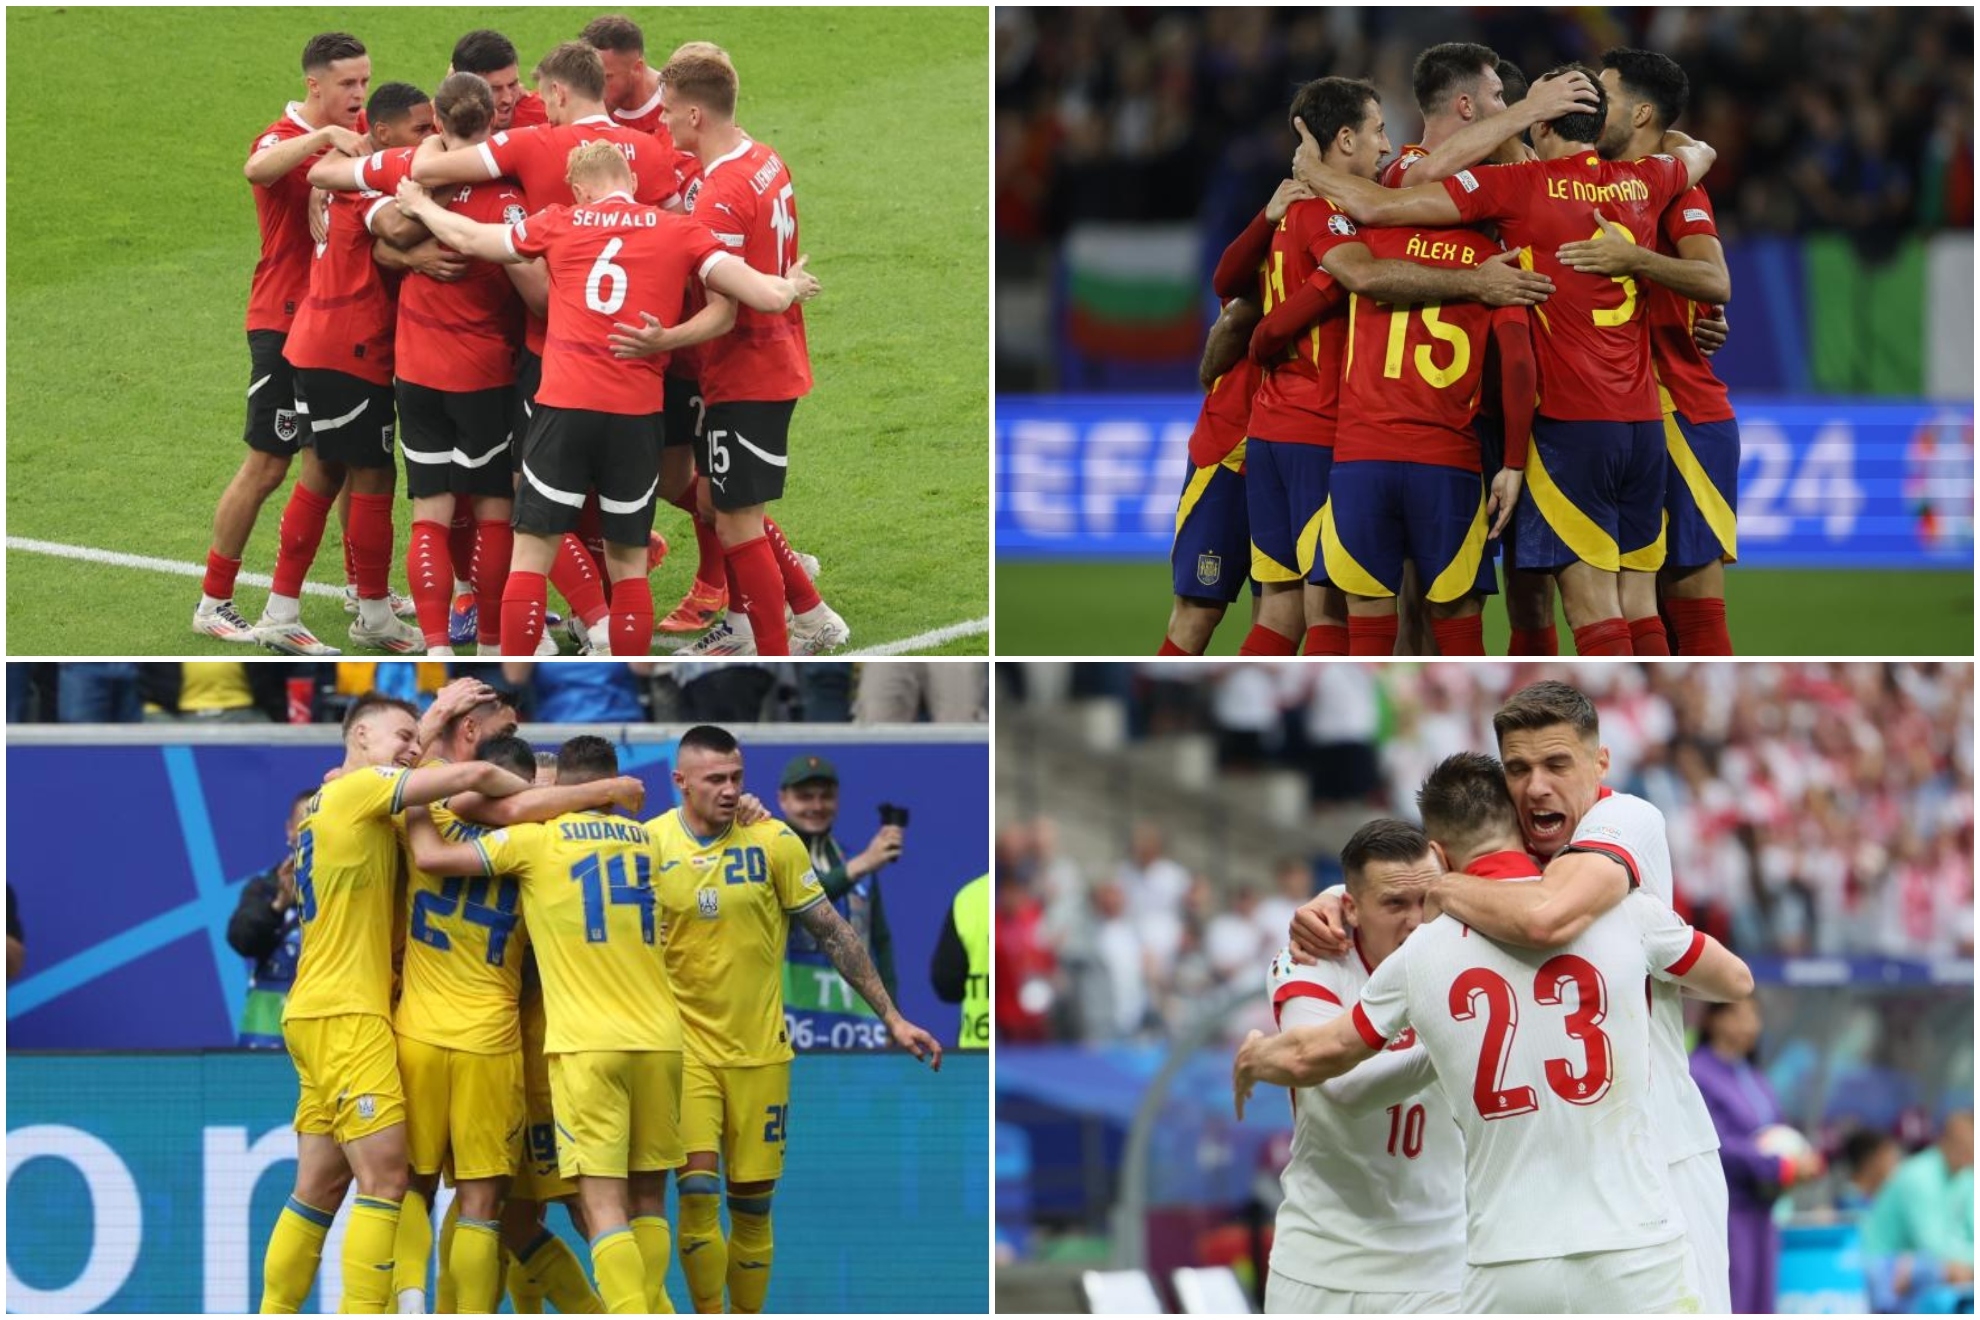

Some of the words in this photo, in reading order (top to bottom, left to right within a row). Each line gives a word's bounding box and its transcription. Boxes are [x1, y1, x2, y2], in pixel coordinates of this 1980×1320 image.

[573, 208, 657, 228] SEIWALD
[1547, 177, 1569, 200] LE
[585, 237, 628, 315] 6
[1406, 234, 1455, 261] ÁLEX
[1376, 299, 1471, 389] 15
[707, 430, 730, 474] 15
[994, 419, 1198, 539] EFA
[570, 851, 656, 946] 14
[724, 846, 767, 885] 20
[410, 876, 520, 968] 24
[1448, 953, 1613, 1121] 23
[1386, 1103, 1426, 1160] 10
